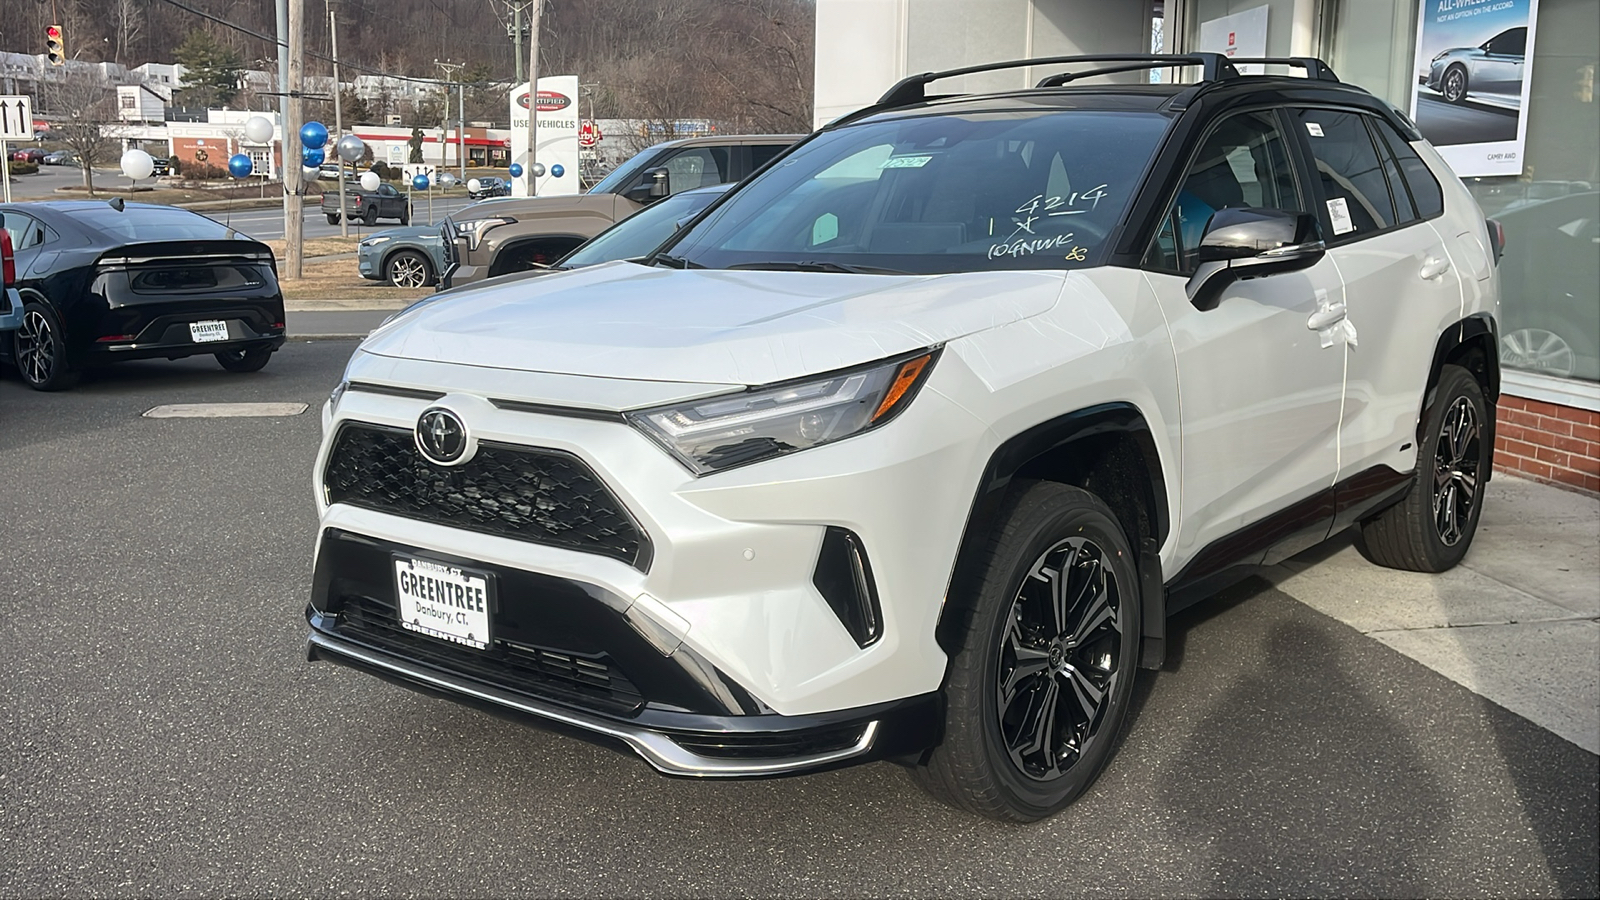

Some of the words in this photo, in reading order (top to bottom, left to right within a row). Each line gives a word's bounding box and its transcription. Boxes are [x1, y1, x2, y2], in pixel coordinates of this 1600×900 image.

[1437, 0, 1486, 13] ALL-WH
[1437, 14, 1447, 23] NOT
[1455, 10, 1473, 20] OPTION
[1473, 8, 1482, 16] ON
[1482, 5, 1492, 14] THE
[513, 119, 530, 128] USE
[537, 120, 575, 128] VEHICLES
[1015, 184, 1108, 214] 4214
[192, 324, 225, 333] GREENTREE
[401, 570, 484, 613] GREENTREE
[416, 601, 454, 625] Danbury,
[455, 611, 469, 626] CT.
[402, 622, 485, 650] GREENTREE
